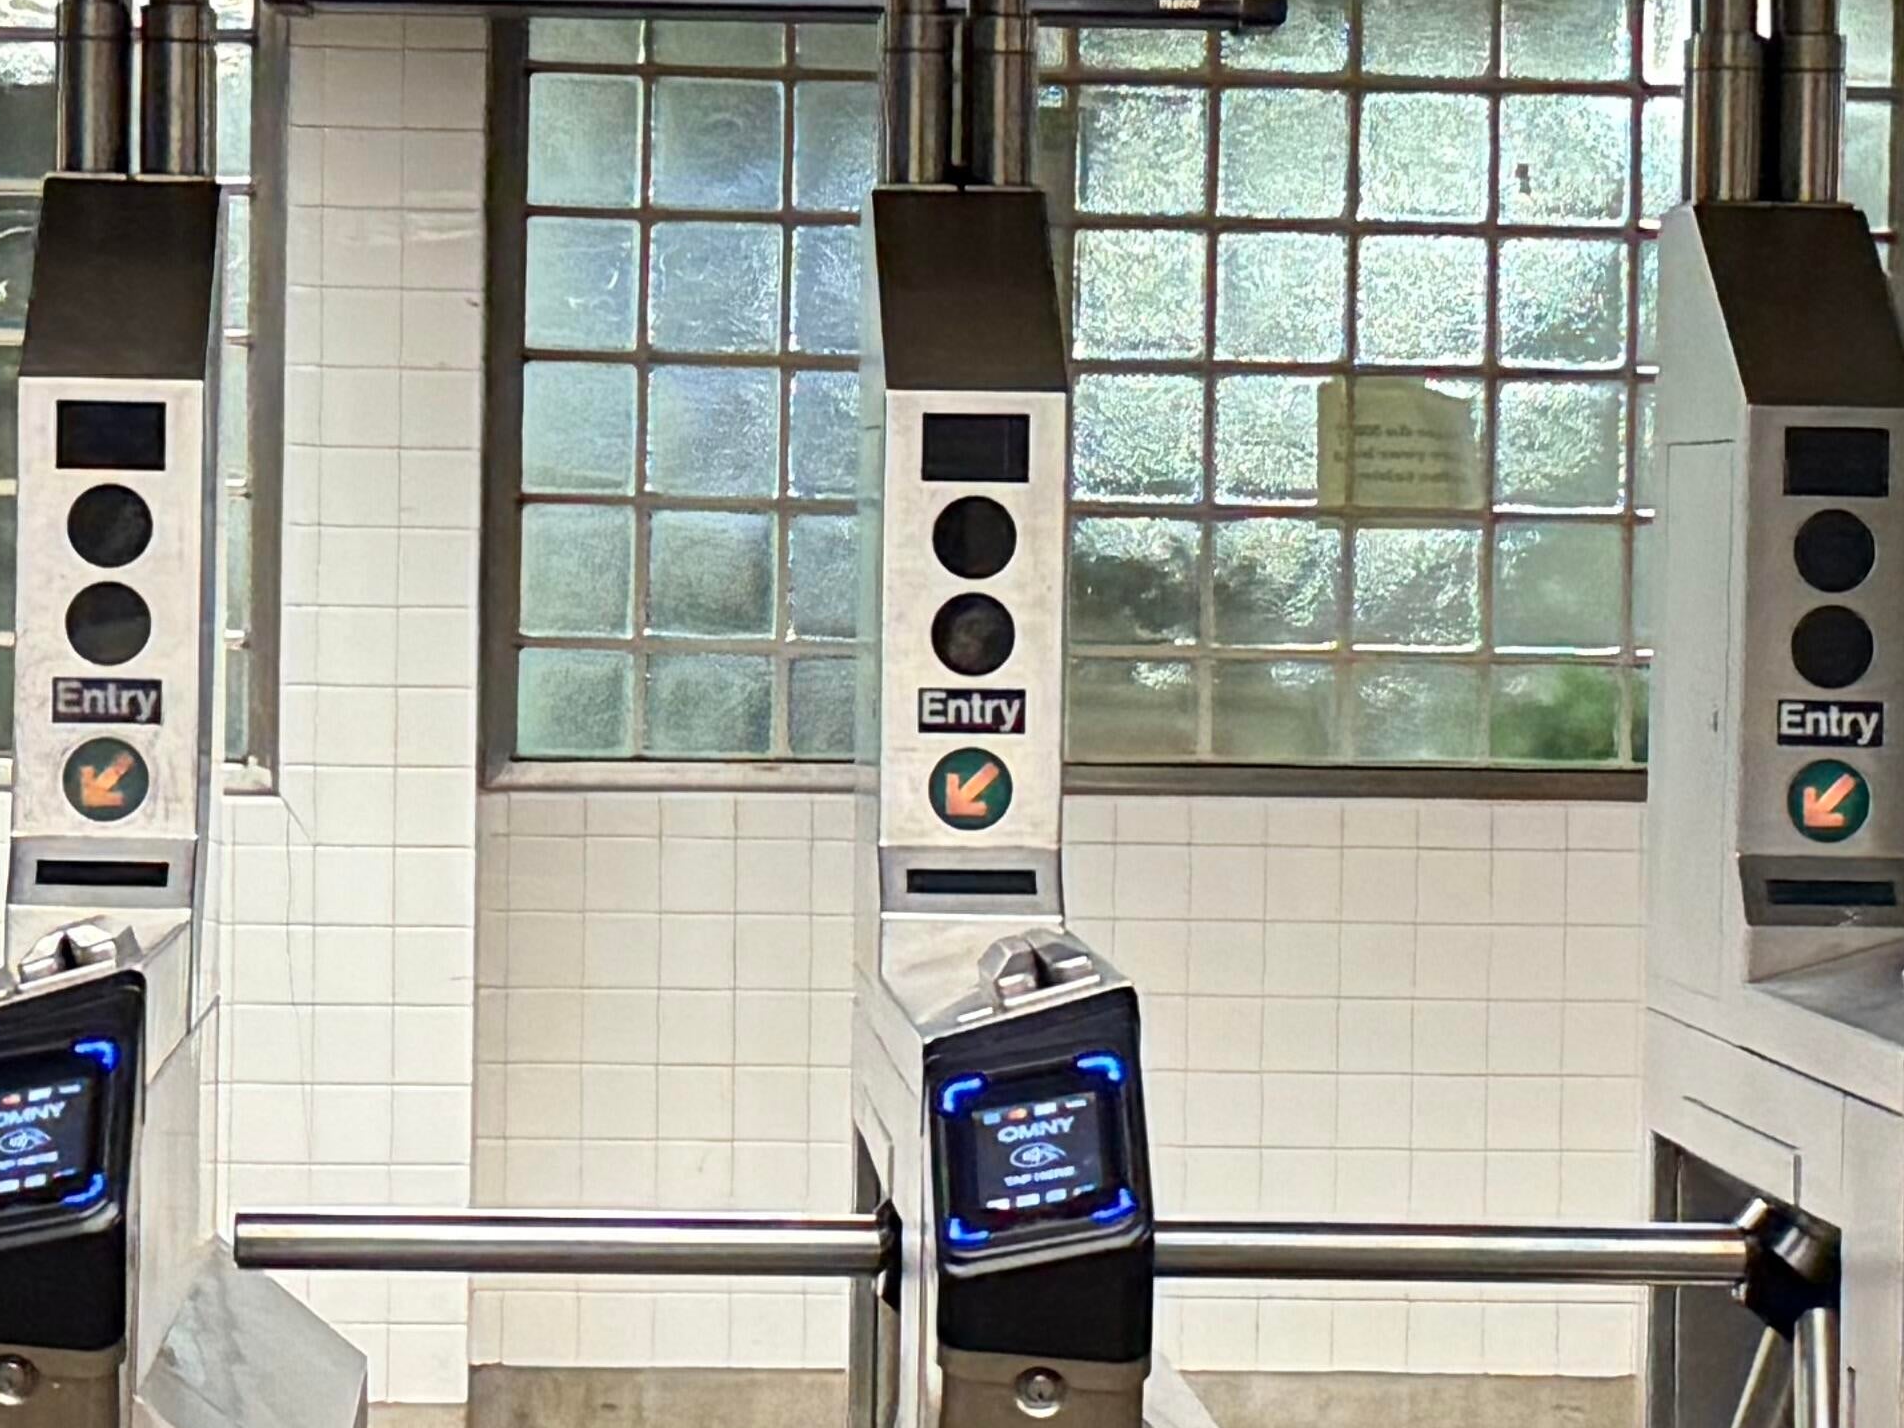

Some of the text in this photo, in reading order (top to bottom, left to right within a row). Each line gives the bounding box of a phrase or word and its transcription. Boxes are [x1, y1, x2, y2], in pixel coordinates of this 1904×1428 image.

[56, 680, 158, 722] Entry
[921, 691, 1021, 732] Entry
[1780, 703, 1880, 745] Entry
[997, 1115, 1075, 1143] OMNY
